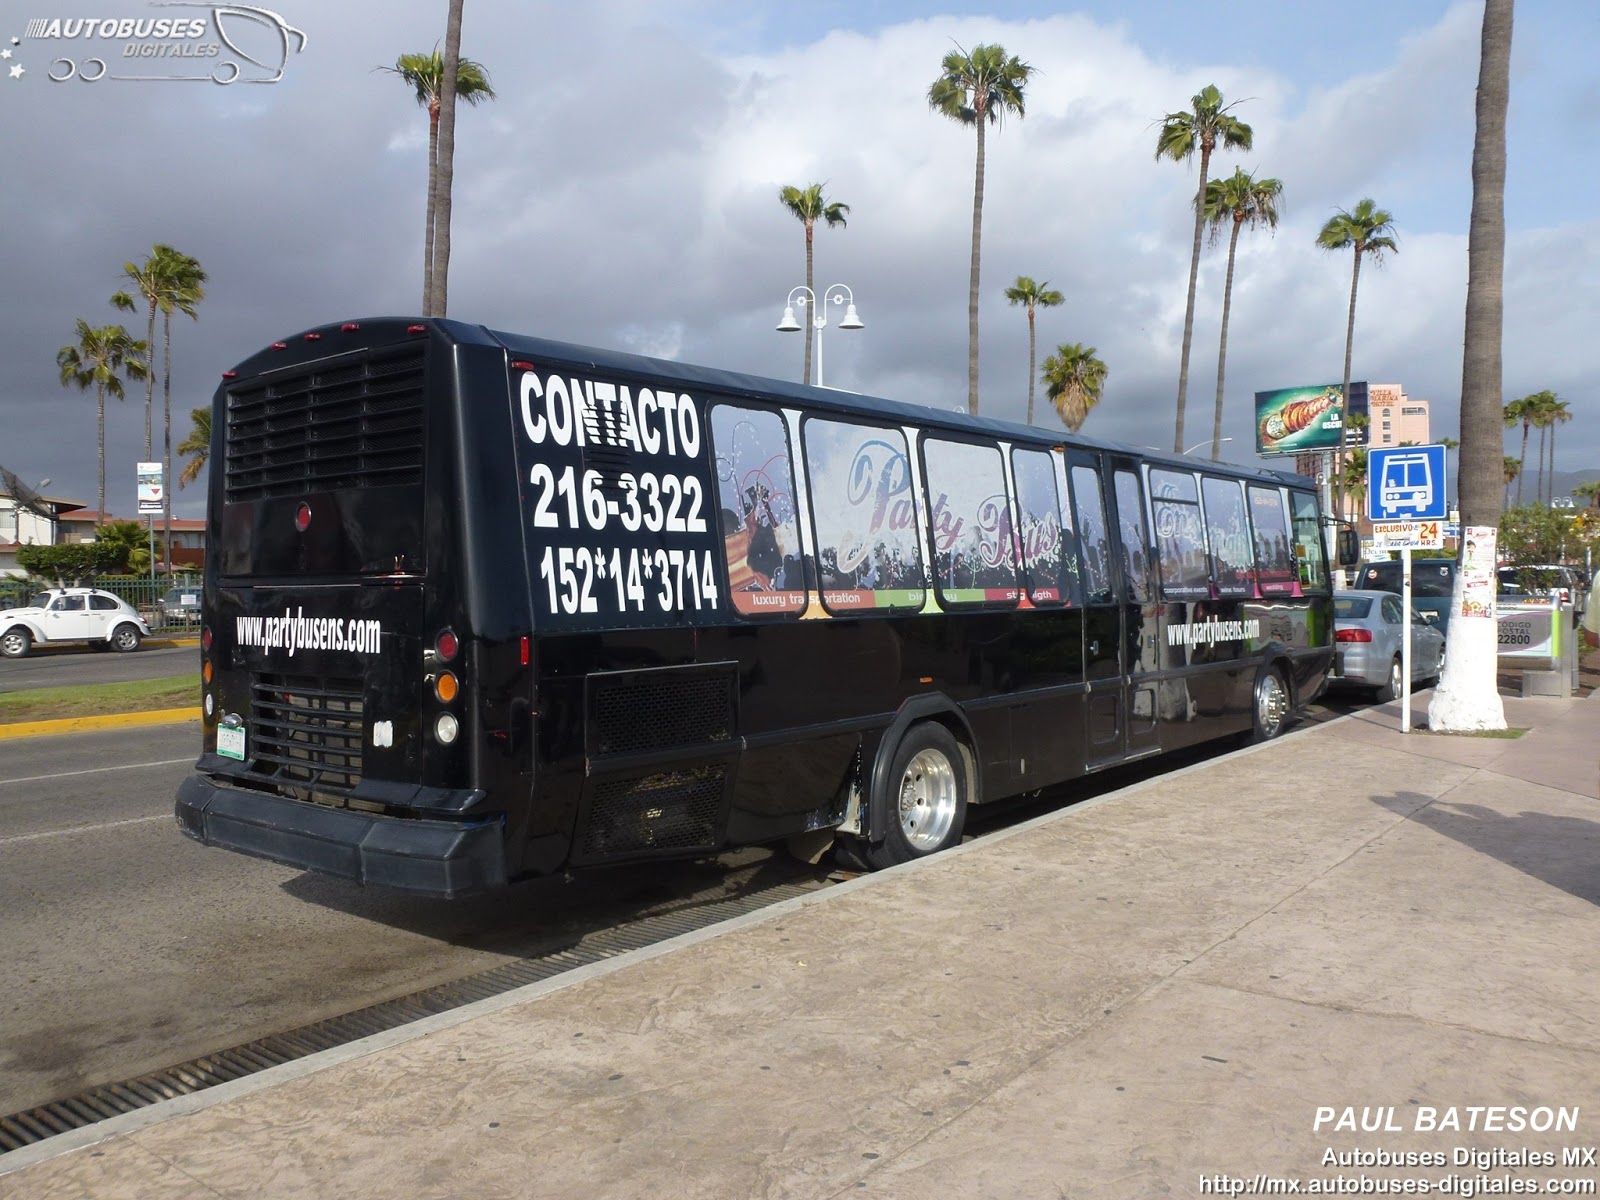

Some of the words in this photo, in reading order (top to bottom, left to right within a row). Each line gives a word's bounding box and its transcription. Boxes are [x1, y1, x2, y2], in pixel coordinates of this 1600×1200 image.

[520, 371, 701, 459] CONTACTO
[530, 463, 707, 533] 216-3322
[1374, 523, 1413, 533] EXCLUSIVO
[1420, 522, 1438, 539] 24
[752, 594, 786, 607] luxury
[789, 593, 861, 605] trasprtation
[236, 606, 382, 658] www.partybusens.com
[1167, 615, 1260, 650] www.partybusens.com
[1497, 634, 1530, 645] 22800
